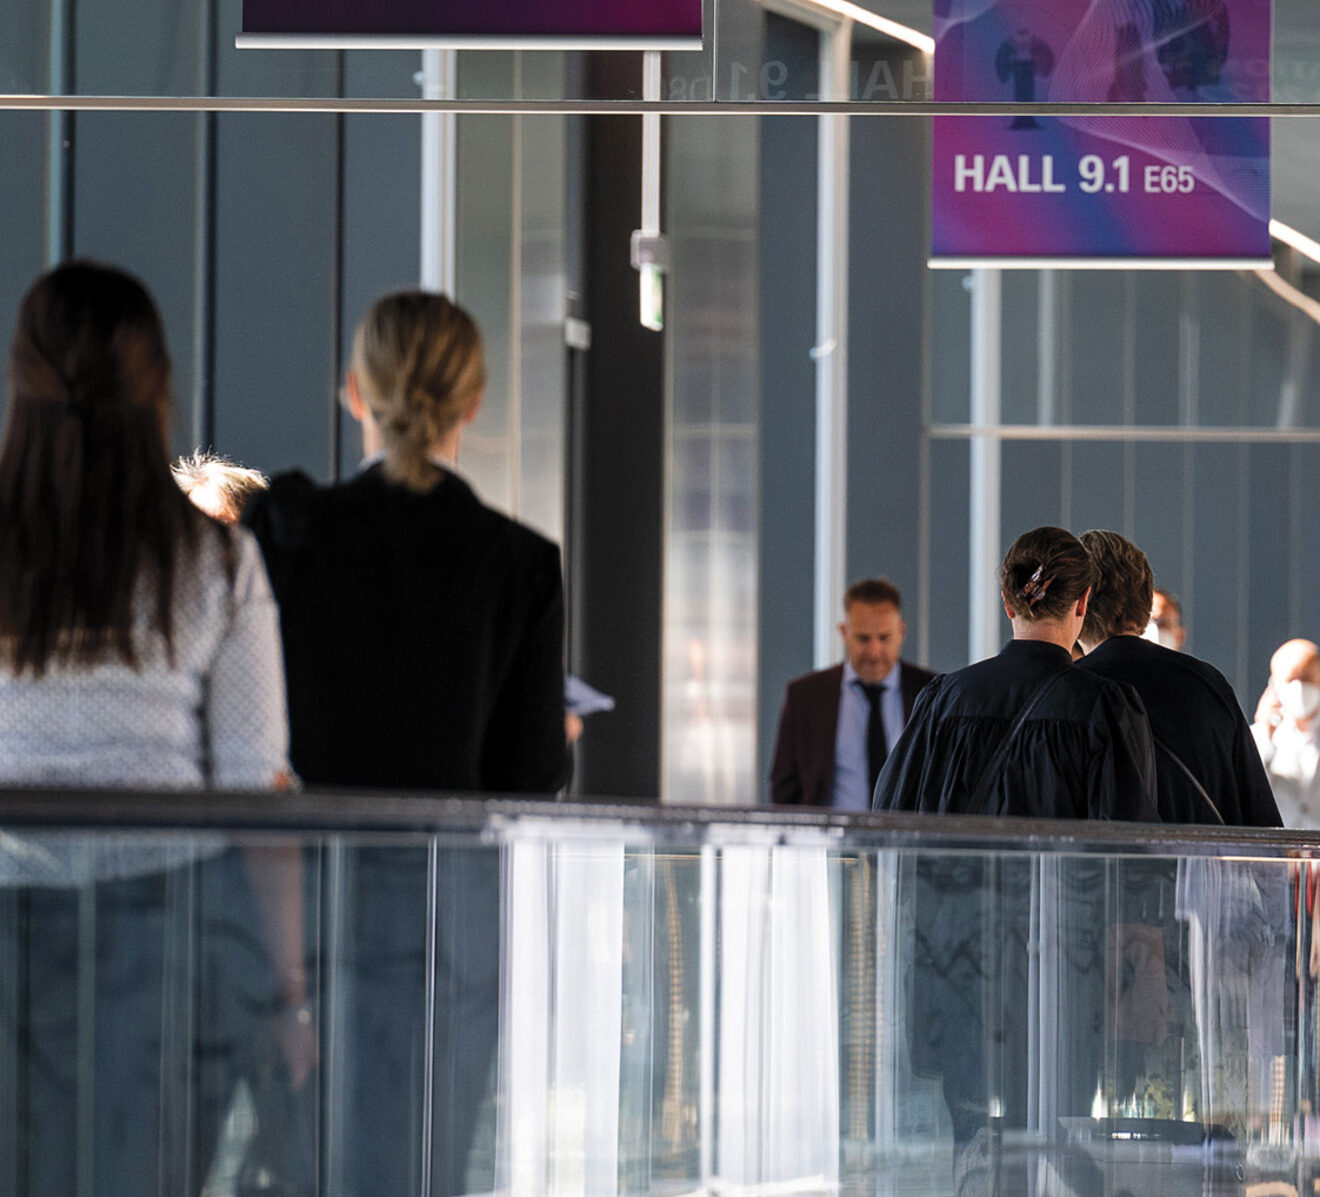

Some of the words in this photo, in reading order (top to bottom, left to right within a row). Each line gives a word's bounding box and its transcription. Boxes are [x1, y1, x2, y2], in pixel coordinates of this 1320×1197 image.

[953, 154, 1065, 194] HALL
[1078, 154, 1130, 194] 9.1
[1144, 166, 1195, 195] E65
